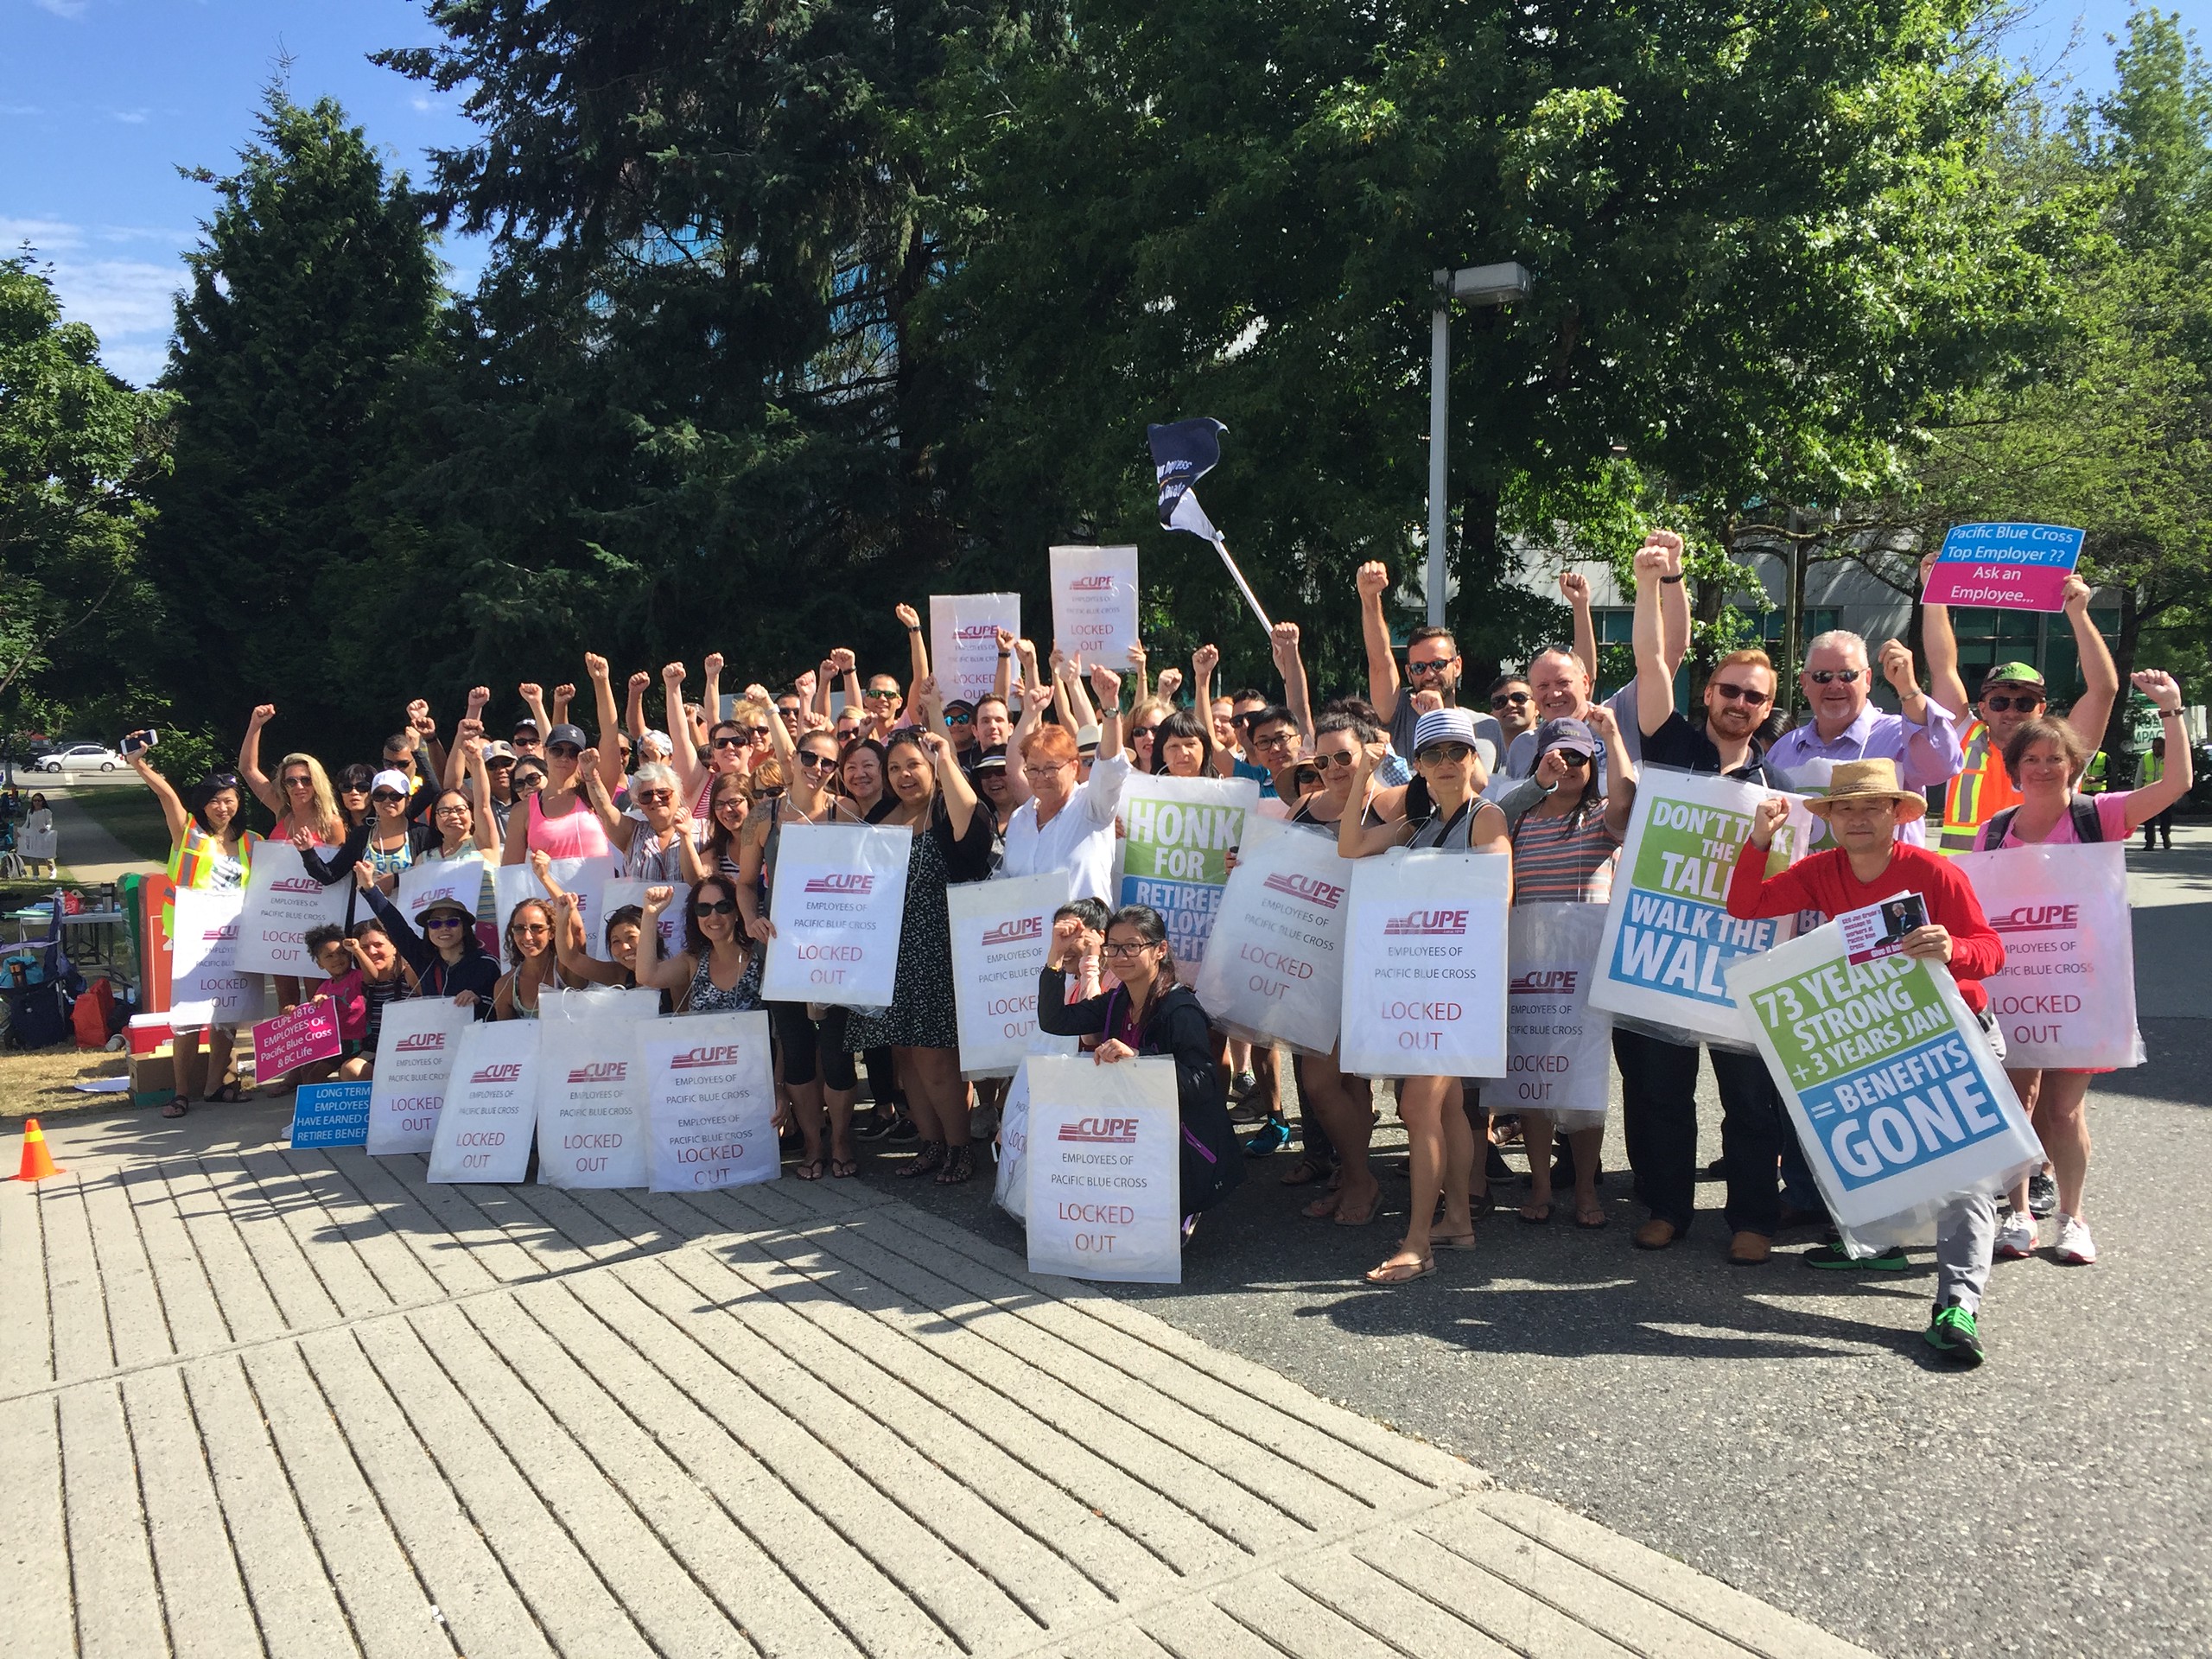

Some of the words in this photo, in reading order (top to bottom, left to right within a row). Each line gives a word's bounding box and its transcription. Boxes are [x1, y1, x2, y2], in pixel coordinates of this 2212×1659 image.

[1952, 526, 1993, 539] Pacific
[1996, 526, 2029, 539] Blue
[2032, 527, 2074, 543] Cross
[1948, 546, 1972, 562] Top
[1975, 546, 2046, 563] Employer
[2050, 550, 2065, 562] ??
[1974, 566, 1999, 579] Ask
[2002, 570, 2021, 580] an
[1951, 586, 2034, 603] Employee...
[966, 626, 998, 635] CUPE
[1071, 625, 1113, 635] LOCKED
[1080, 641, 1103, 650] OUT
[954, 674, 995, 684] LOCKED
[1129, 801, 1241, 849] HONK
[1653, 801, 1732, 838] DON'T
[1702, 839, 1735, 862] THE
[1154, 848, 1205, 879] FOR
[285, 878, 323, 890] CUPE
[825, 874, 874, 888] CUPE
[1661, 851, 1735, 902] TAL
[422, 887, 454, 900] CUPE
[1286, 874, 1345, 903] CUPE
[270, 898, 308, 906] EMPLOYEES
[1137, 881, 1224, 912] RETIREE
[807, 902, 854, 911] EMPLOYEES
[1262, 899, 1313, 923] EMPLOYEES
[1315, 917, 1329, 927] OF
[1408, 911, 1469, 927] CUPE
[1631, 894, 1713, 938] WALK
[1716, 912, 1770, 950] THE
[2011, 905, 2079, 925] CUPE
[794, 919, 824, 928] PACIFIC
[849, 921, 876, 930] CROSS
[998, 917, 1042, 937] CUPE
[263, 931, 302, 944] LOCKE
[1244, 914, 1275, 932] PACIFIC
[1278, 925, 1301, 940] BLUE
[1303, 934, 1333, 951] CROSS
[798, 945, 862, 961] LOCKED
[1389, 947, 1446, 956] EMPLOYEES
[1449, 947, 1462, 956] OF
[2061, 942, 2075, 951] OF
[271, 949, 300, 961] OUT
[987, 948, 1031, 963] EMPLOYEES
[1033, 948, 1043, 957] OF
[1241, 944, 1313, 979] LOCKED
[1621, 925, 1730, 1000] WAL
[810, 969, 845, 984] OUT
[979, 971, 1007, 983] PACIFIC
[1010, 969, 1028, 978] BLUE
[1375, 969, 1411, 978] PACIFIC
[1414, 969, 1439, 978] BLUE
[1442, 969, 1476, 978] CROSS
[2024, 965, 2051, 975] BLUE
[2056, 963, 2094, 973] CROSS
[200, 978, 247, 990] LOCKED
[1526, 971, 1578, 988] CUPE
[1249, 976, 1290, 1000] OUT
[1756, 988, 1804, 1028] 73
[1799, 954, 1916, 1009] YEARS
[212, 996, 237, 1007] OUT
[988, 995, 1036, 1015] LOCKE
[1993, 995, 2081, 1014] LOCKED
[293, 1005, 316, 1019] 1816
[1382, 1002, 1462, 1020] LOCKED
[1511, 1005, 1556, 1014] EMPLOYEES
[1793, 981, 1914, 1052] STRONG
[264, 1020, 309, 1047] EMPLOYEES
[311, 1016, 326, 1027] OF
[1004, 1021, 1036, 1038] OUT
[1530, 1026, 1549, 1034] BLUE
[1552, 1026, 1582, 1035] CROSS
[2014, 1026, 2062, 1043] OUT
[261, 1046, 284, 1061] Pacific
[287, 1037, 303, 1051] Blue
[305, 1029, 332, 1041] Cross
[408, 1033, 446, 1046] CUPE
[1399, 1032, 1442, 1050] OUT
[1811, 1054, 1827, 1075] 3
[1826, 1024, 1902, 1067] YEARS
[1902, 1001, 1948, 1040] JAN
[277, 1059, 283, 1068] &
[284, 1053, 295, 1065] BC
[296, 1047, 312, 1062] Life
[689, 1046, 739, 1061] CUPE
[485, 1065, 522, 1077] CUPE
[584, 1062, 627, 1076] CUPE
[1507, 1055, 1568, 1072] LOCKED
[676, 1076, 723, 1085] EMPLOYEES
[1834, 1039, 1968, 1114] BENEFITS
[316, 1089, 342, 1098] LONG
[346, 1087, 370, 1096] TERM
[570, 1090, 612, 1099] EMPLOYEES
[613, 1090, 623, 1098] OF
[666, 1095, 696, 1103] PACIFIC
[721, 1090, 749, 1099] CROSS
[1519, 1083, 1553, 1099] OUT
[315, 1101, 369, 1111] EMPLOYEES
[392, 1097, 443, 1111] LOCKED
[560, 1108, 587, 1116] PACIFIC
[297, 1116, 321, 1126] HAVE
[323, 1115, 361, 1125] EARNED
[402, 1118, 432, 1131] OUT
[678, 1117, 726, 1128] EMPLOYEES
[1078, 1118, 1139, 1136] CUPE
[1831, 1071, 1999, 1177] GONE
[297, 1130, 332, 1141] RETIREE
[456, 1133, 505, 1147] LOCKED
[565, 1134, 622, 1148] LOCKED
[670, 1135, 699, 1145] PACIFIC
[702, 1133, 722, 1141] BLUE
[725, 1130, 753, 1140] CROSS
[678, 1144, 743, 1163] LOCKED
[1062, 1153, 1117, 1165] EMPLOYEES
[1120, 1156, 1134, 1165] OF
[463, 1155, 490, 1168] OUT
[576, 1158, 608, 1172] OUT
[695, 1168, 730, 1185] OUT
[1052, 1174, 1084, 1185] PACIFIC
[1087, 1177, 1110, 1186] BLUE
[1114, 1178, 1147, 1188] CROSS
[1058, 1202, 1134, 1224] LOCKED
[1075, 1233, 1116, 1252] OUT
